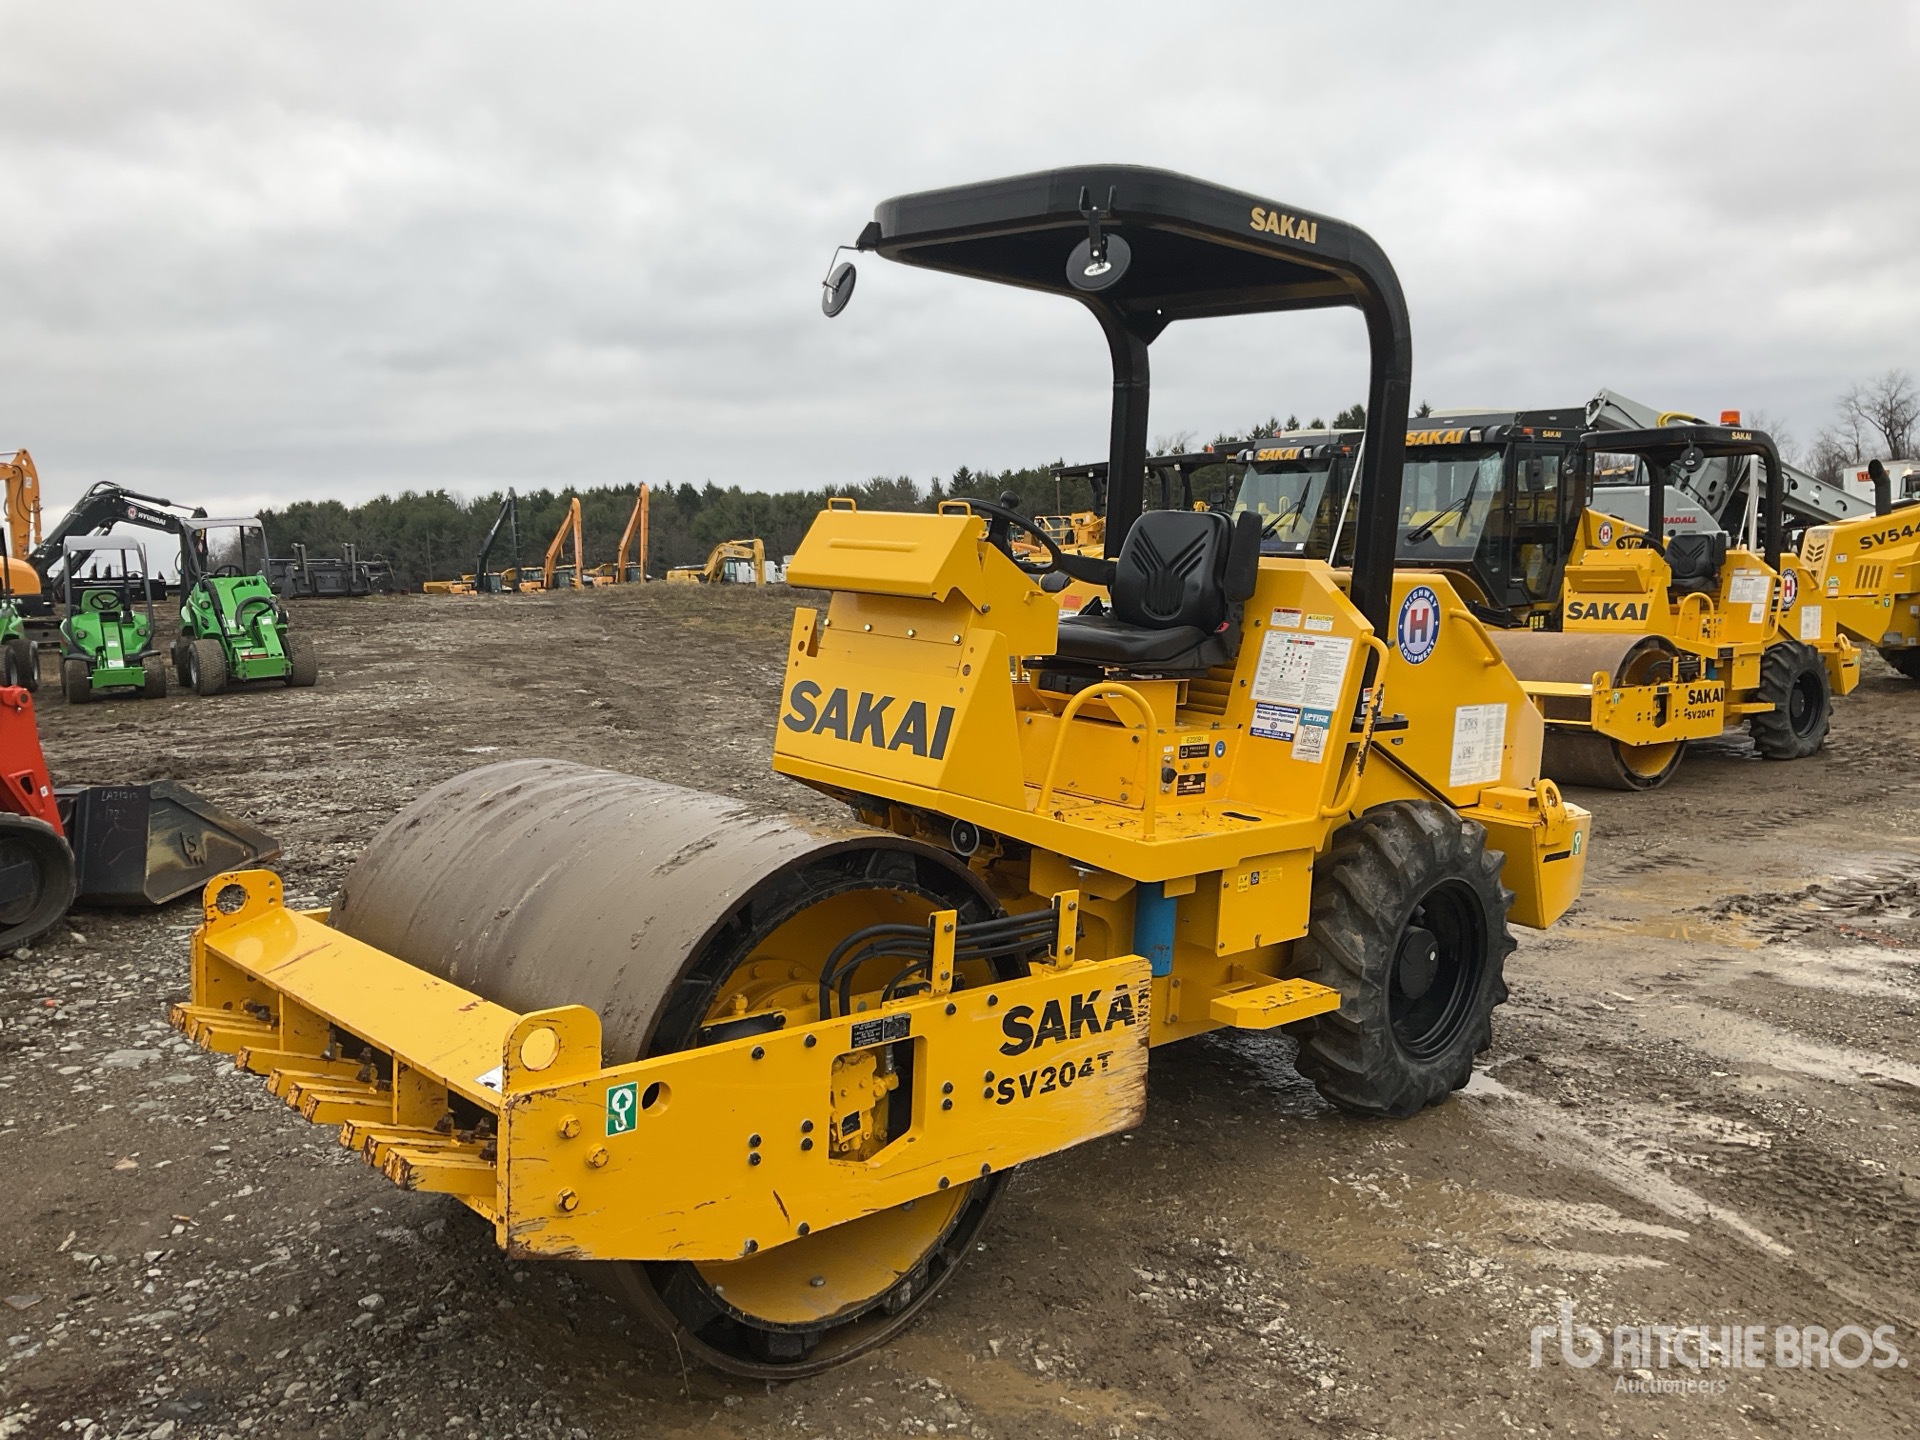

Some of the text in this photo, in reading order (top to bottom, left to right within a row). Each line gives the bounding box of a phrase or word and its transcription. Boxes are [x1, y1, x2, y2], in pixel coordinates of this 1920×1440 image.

[1250, 207, 1317, 244] SAKAI
[1405, 429, 1465, 446] SAKAI
[1543, 430, 1562, 438] SAKAI
[1731, 431, 1752, 440] SAKAI
[1257, 448, 1299, 461] SAKAI
[138, 511, 166, 525] HYUNDAI
[1663, 516, 1697, 524] RADALL
[1404, 589, 1437, 610] HIGHWAY
[1566, 602, 1649, 621] SAKAI
[1409, 608, 1429, 643] H
[1400, 639, 1435, 663] EQUIPMENT
[1688, 688, 1723, 705] SAKAI
[782, 680, 956, 760] SAKAI
[1687, 709, 1715, 719] SV204T
[996, 1051, 1114, 1105] SV204T
